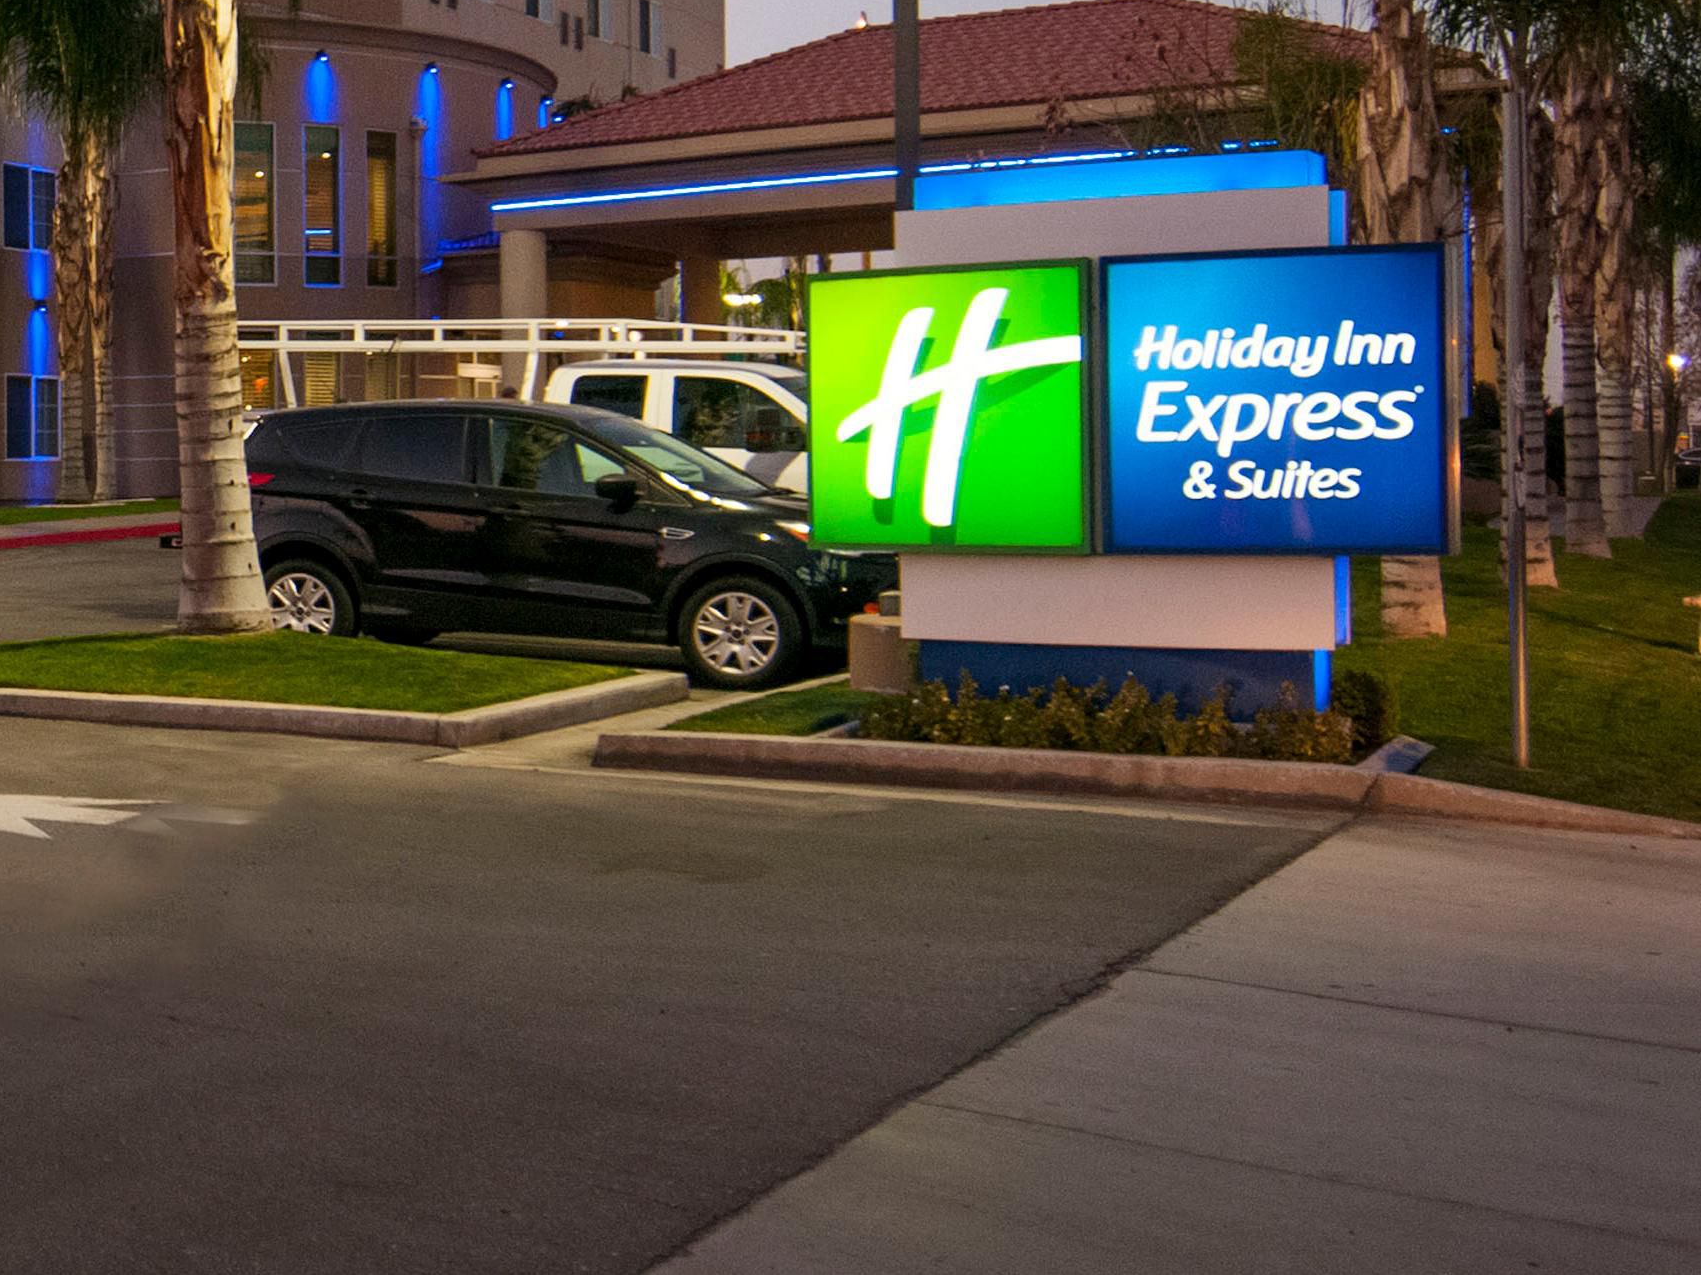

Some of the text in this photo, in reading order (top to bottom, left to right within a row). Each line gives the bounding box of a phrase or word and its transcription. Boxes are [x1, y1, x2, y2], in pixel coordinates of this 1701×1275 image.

[1134, 319, 1416, 378] Holiday Inn
[1136, 380, 1418, 458] Express
[1182, 460, 1362, 500] & Suites
